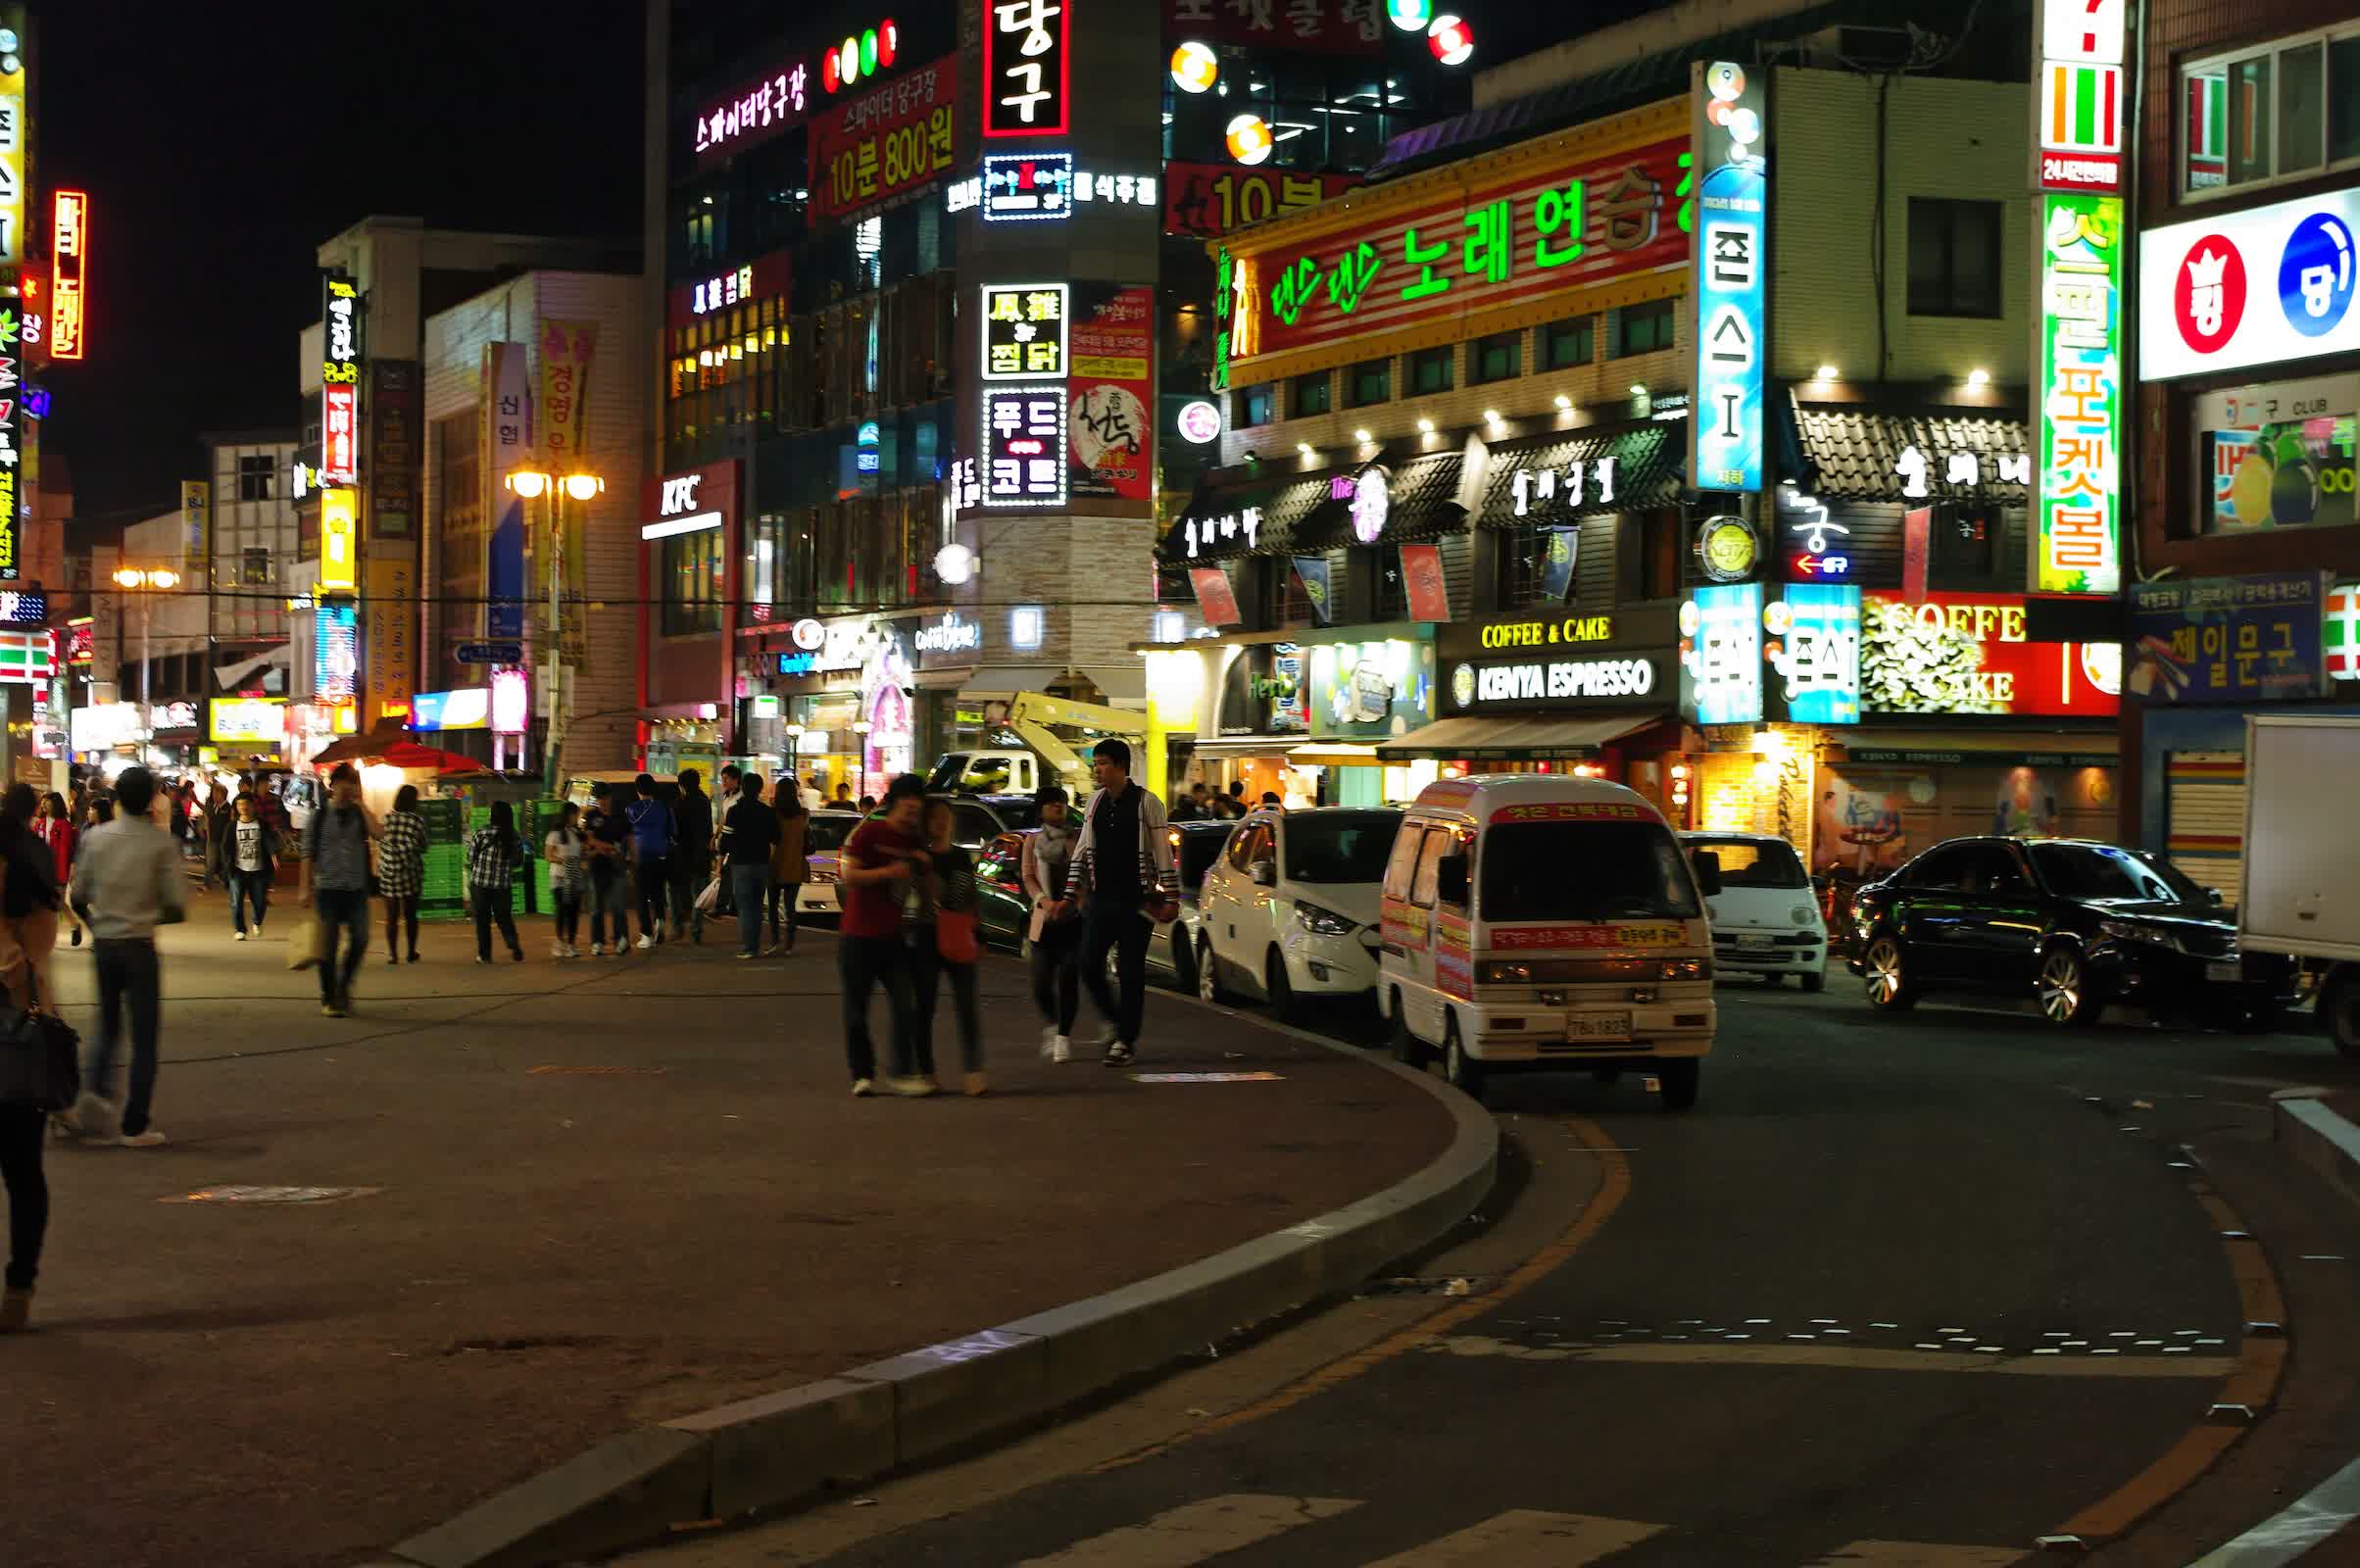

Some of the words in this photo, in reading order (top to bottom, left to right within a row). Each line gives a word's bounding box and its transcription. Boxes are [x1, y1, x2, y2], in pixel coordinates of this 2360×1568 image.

[994, 1, 1061, 122] 당구
[695, 63, 807, 152] 스파이더당구장
[898, 69, 937, 116] 당구장
[831, 141, 879, 205] 10분
[885, 104, 955, 187] 800원
[991, 341, 1059, 372] 찜닭
[993, 401, 1057, 439] 푸드
[2292, 399, 2329, 416] CLUB
[992, 459, 1057, 495] 코트
[2054, 368, 2106, 567] 포켓볼
[661, 473, 702, 516] KFC
[1792, 505, 1850, 555] 궁
[1481, 622, 1545, 648] COFFEE
[1548, 622, 1560, 644] &
[1563, 616, 1611, 643] CAKE
[1884, 603, 2028, 643] COFFE
[2171, 620, 2297, 689] 제일문구
[1478, 663, 1546, 701] KENYA
[1547, 660, 1653, 698] ESPRESSO
[1929, 672, 2014, 702] CAKE
